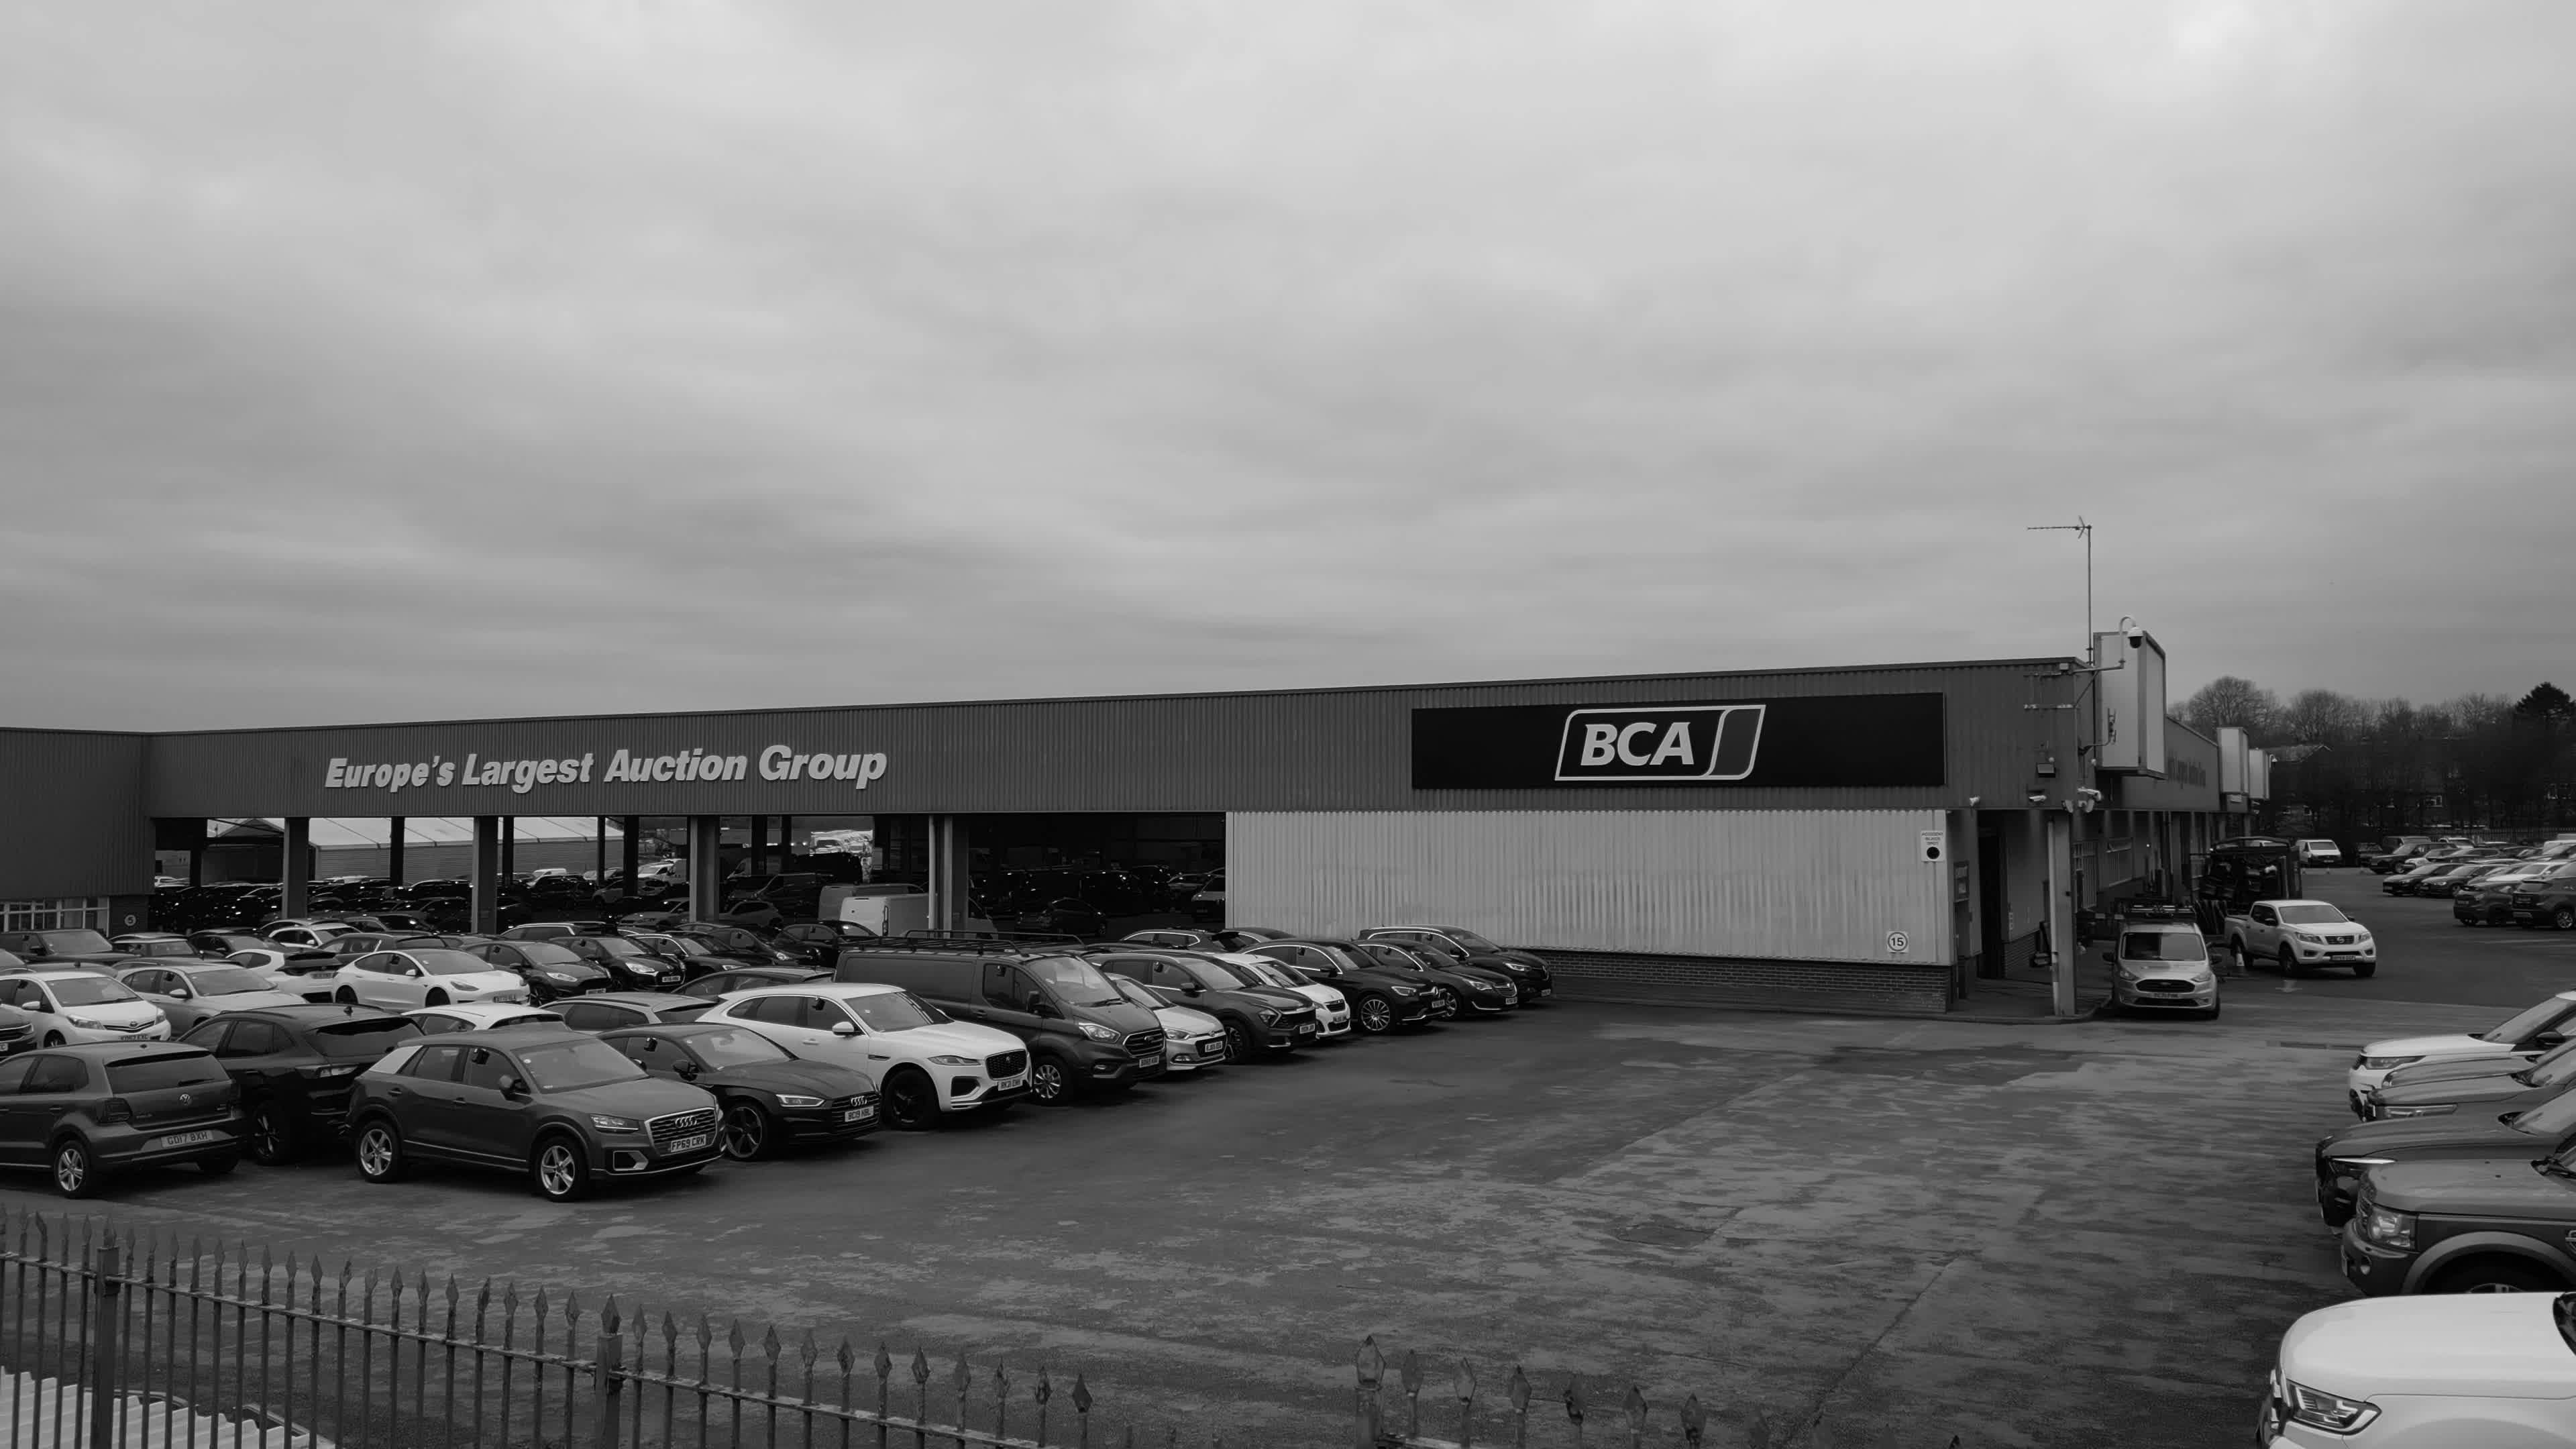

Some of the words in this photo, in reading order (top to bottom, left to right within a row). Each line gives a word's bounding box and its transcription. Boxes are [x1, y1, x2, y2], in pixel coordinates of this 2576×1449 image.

[1580, 722, 1695, 766] BCA
[325, 755, 456, 793] Europe's
[462, 753, 594, 794] Largest
[603, 748, 748, 782] Auction
[759, 745, 888, 790] Group
[1891, 937, 1904, 947] 15
[672, 1138, 690, 1149] FP69
[692, 1134, 705, 1146] CRK
